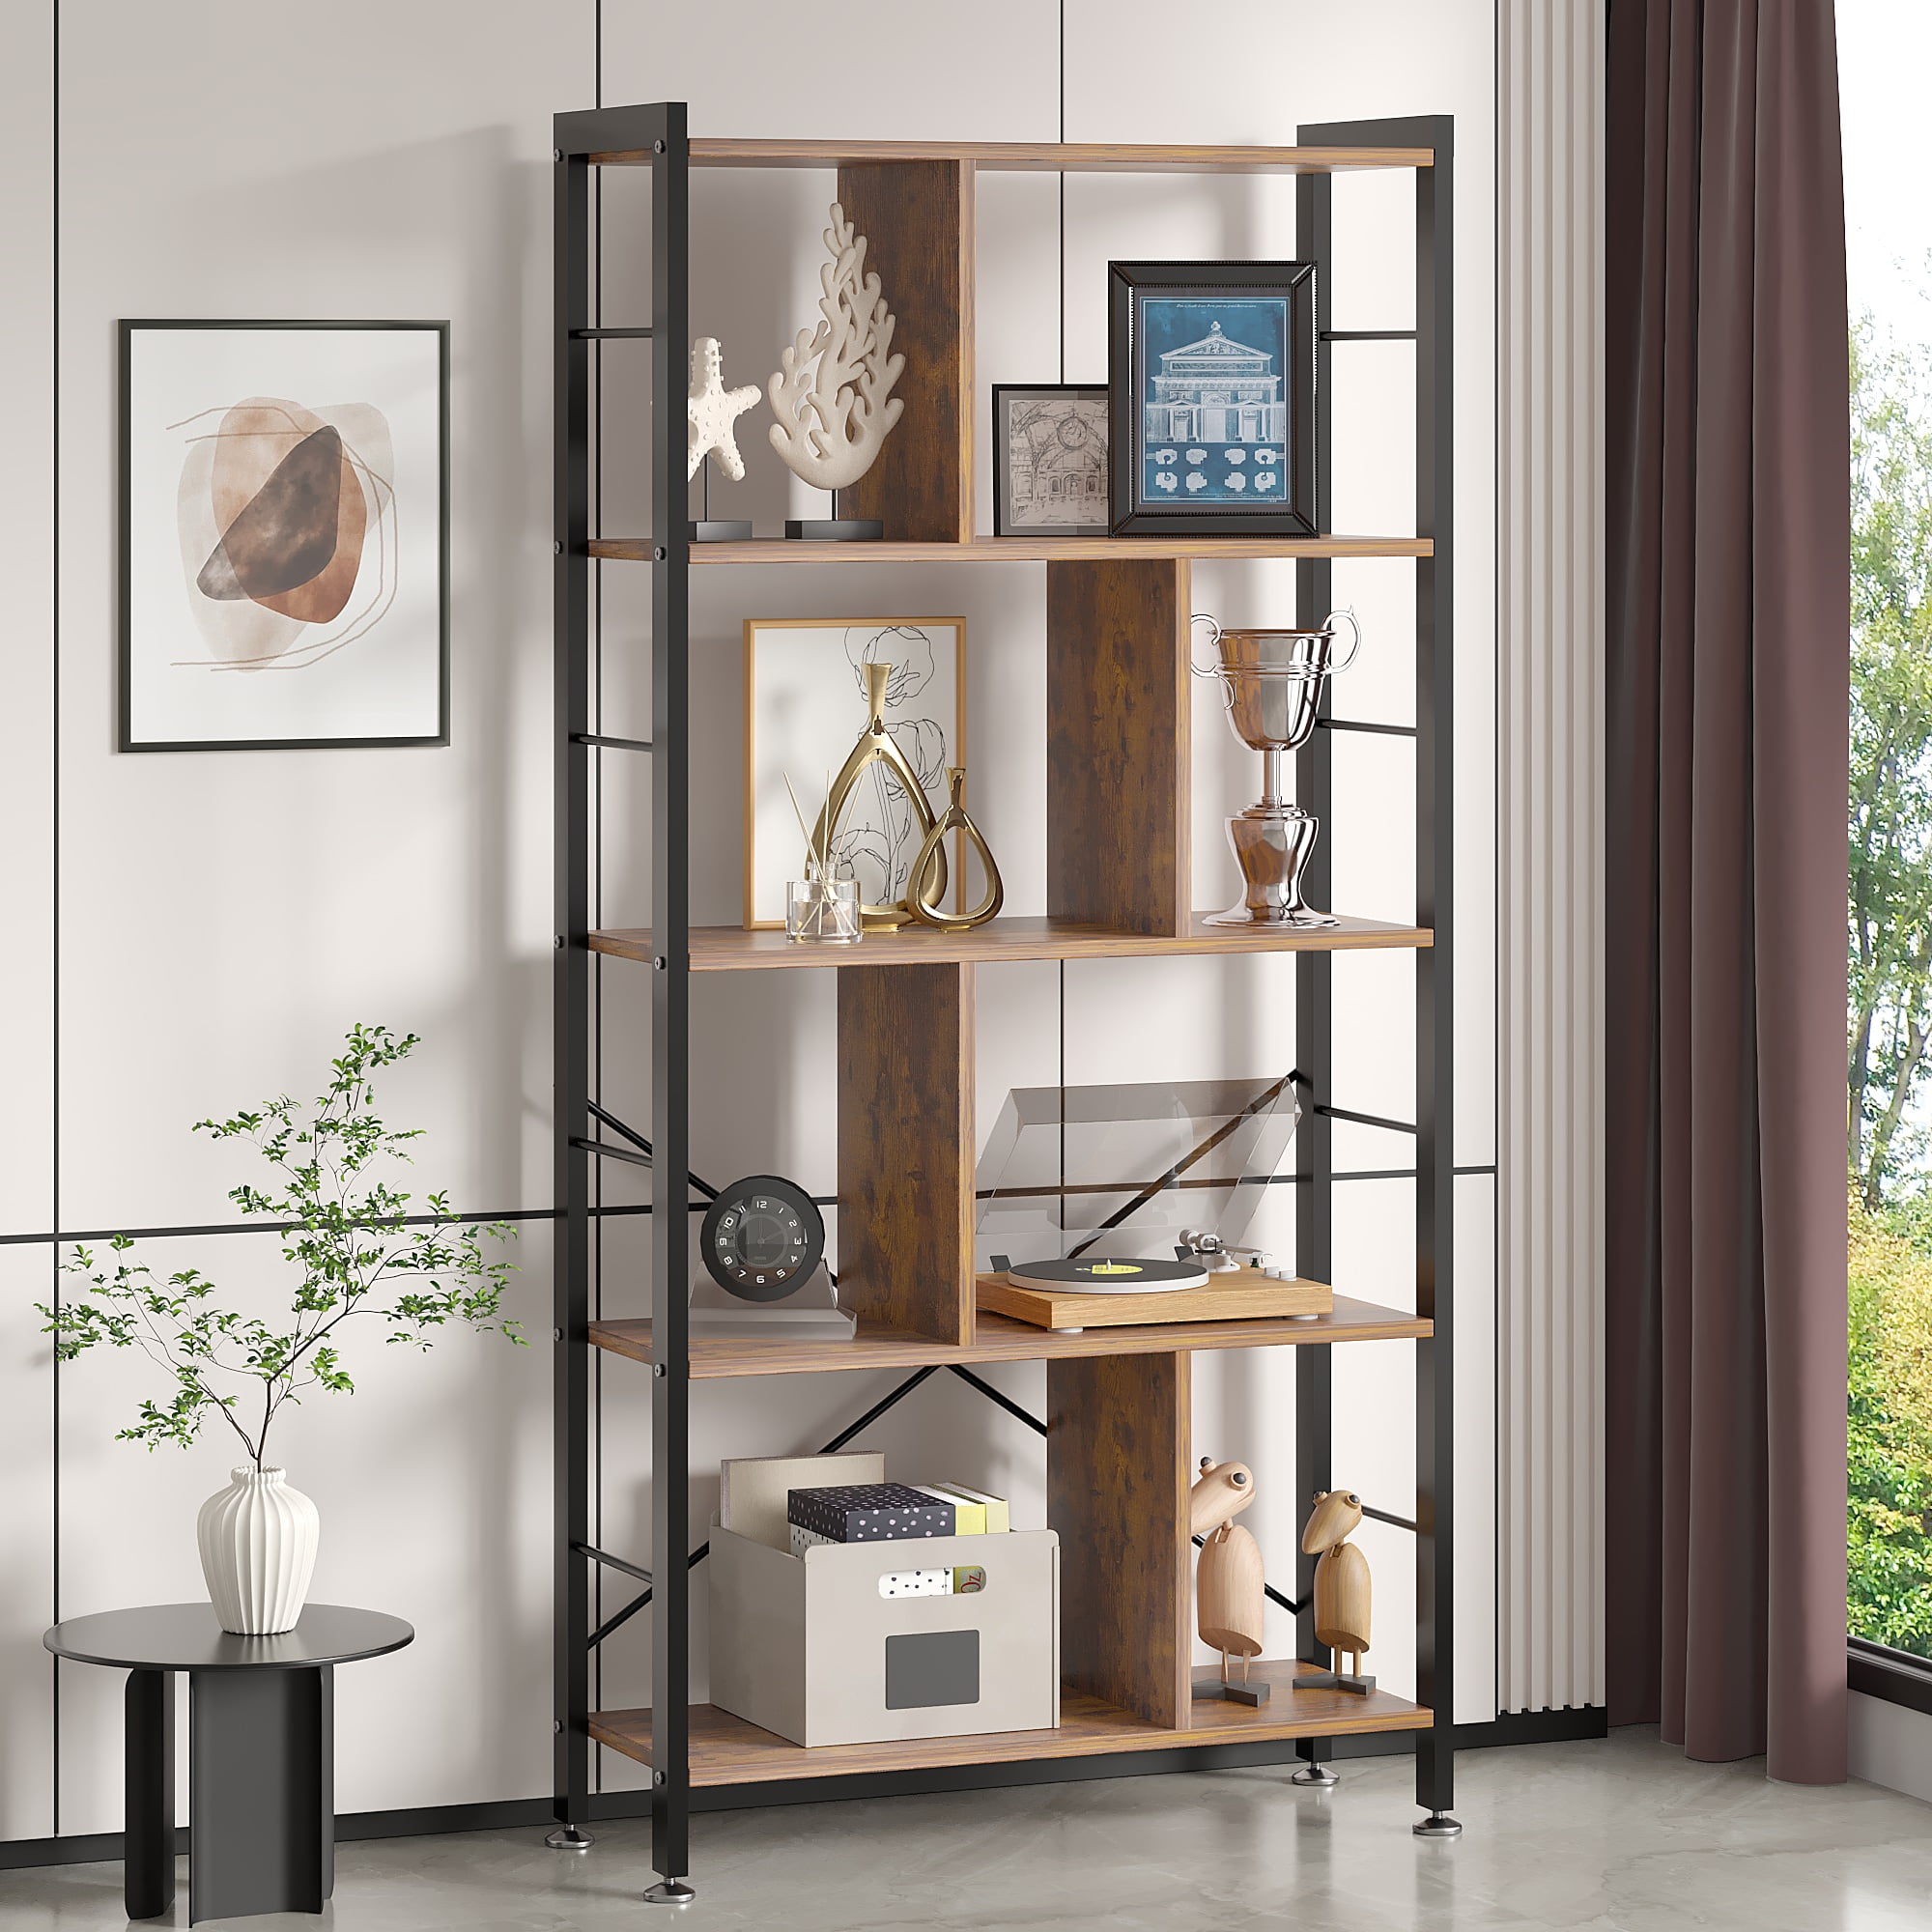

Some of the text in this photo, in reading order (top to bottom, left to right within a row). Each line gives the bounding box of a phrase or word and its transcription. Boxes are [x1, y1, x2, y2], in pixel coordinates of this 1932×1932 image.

[724, 1217, 733, 1229] 10
[720, 1237, 727, 1246] 9
[724, 1256, 732, 1265] 8
[777, 1268, 785, 1278] 5
[756, 1275, 765, 1284] 6
